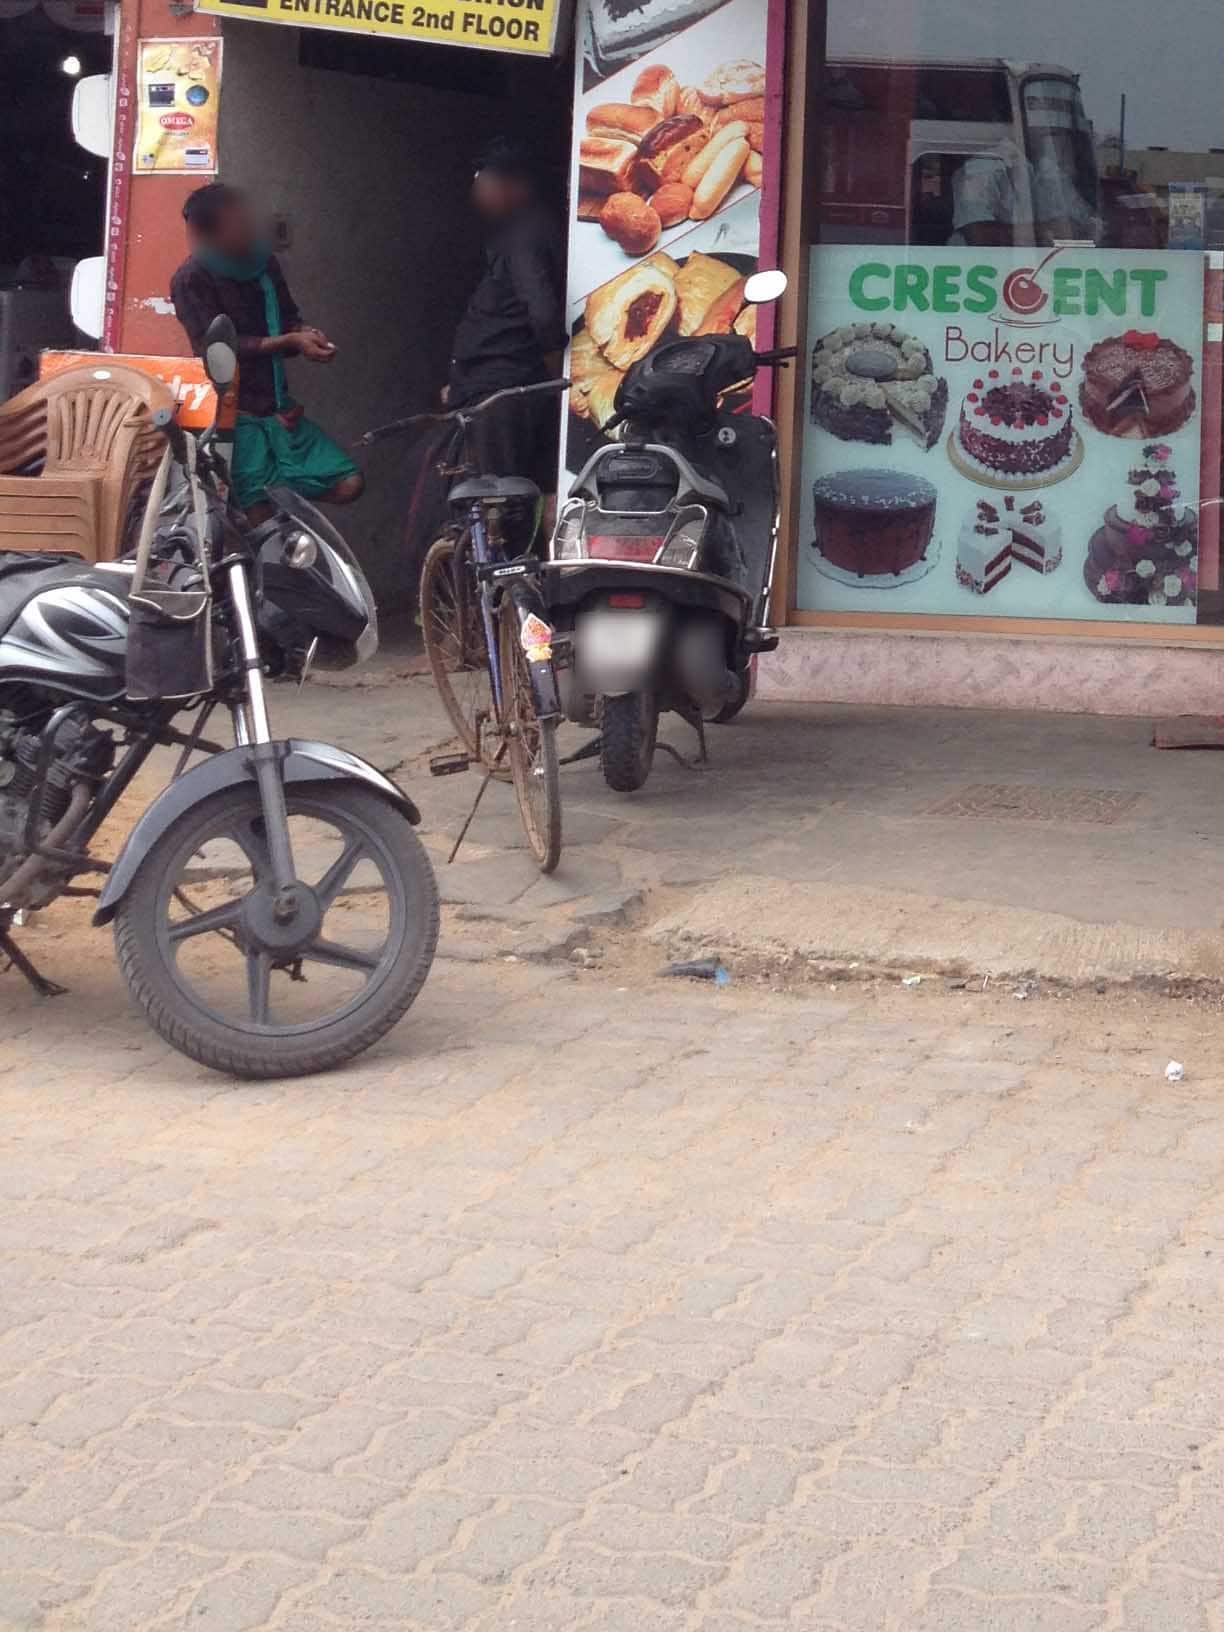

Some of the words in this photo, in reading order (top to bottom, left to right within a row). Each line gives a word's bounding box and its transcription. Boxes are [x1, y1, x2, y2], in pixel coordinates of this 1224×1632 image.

[411, 5, 455, 32] 2nd
[461, 11, 540, 42] FLOOR
[848, 262, 1169, 317] CRESCENT
[944, 326, 1075, 379] Bakery
